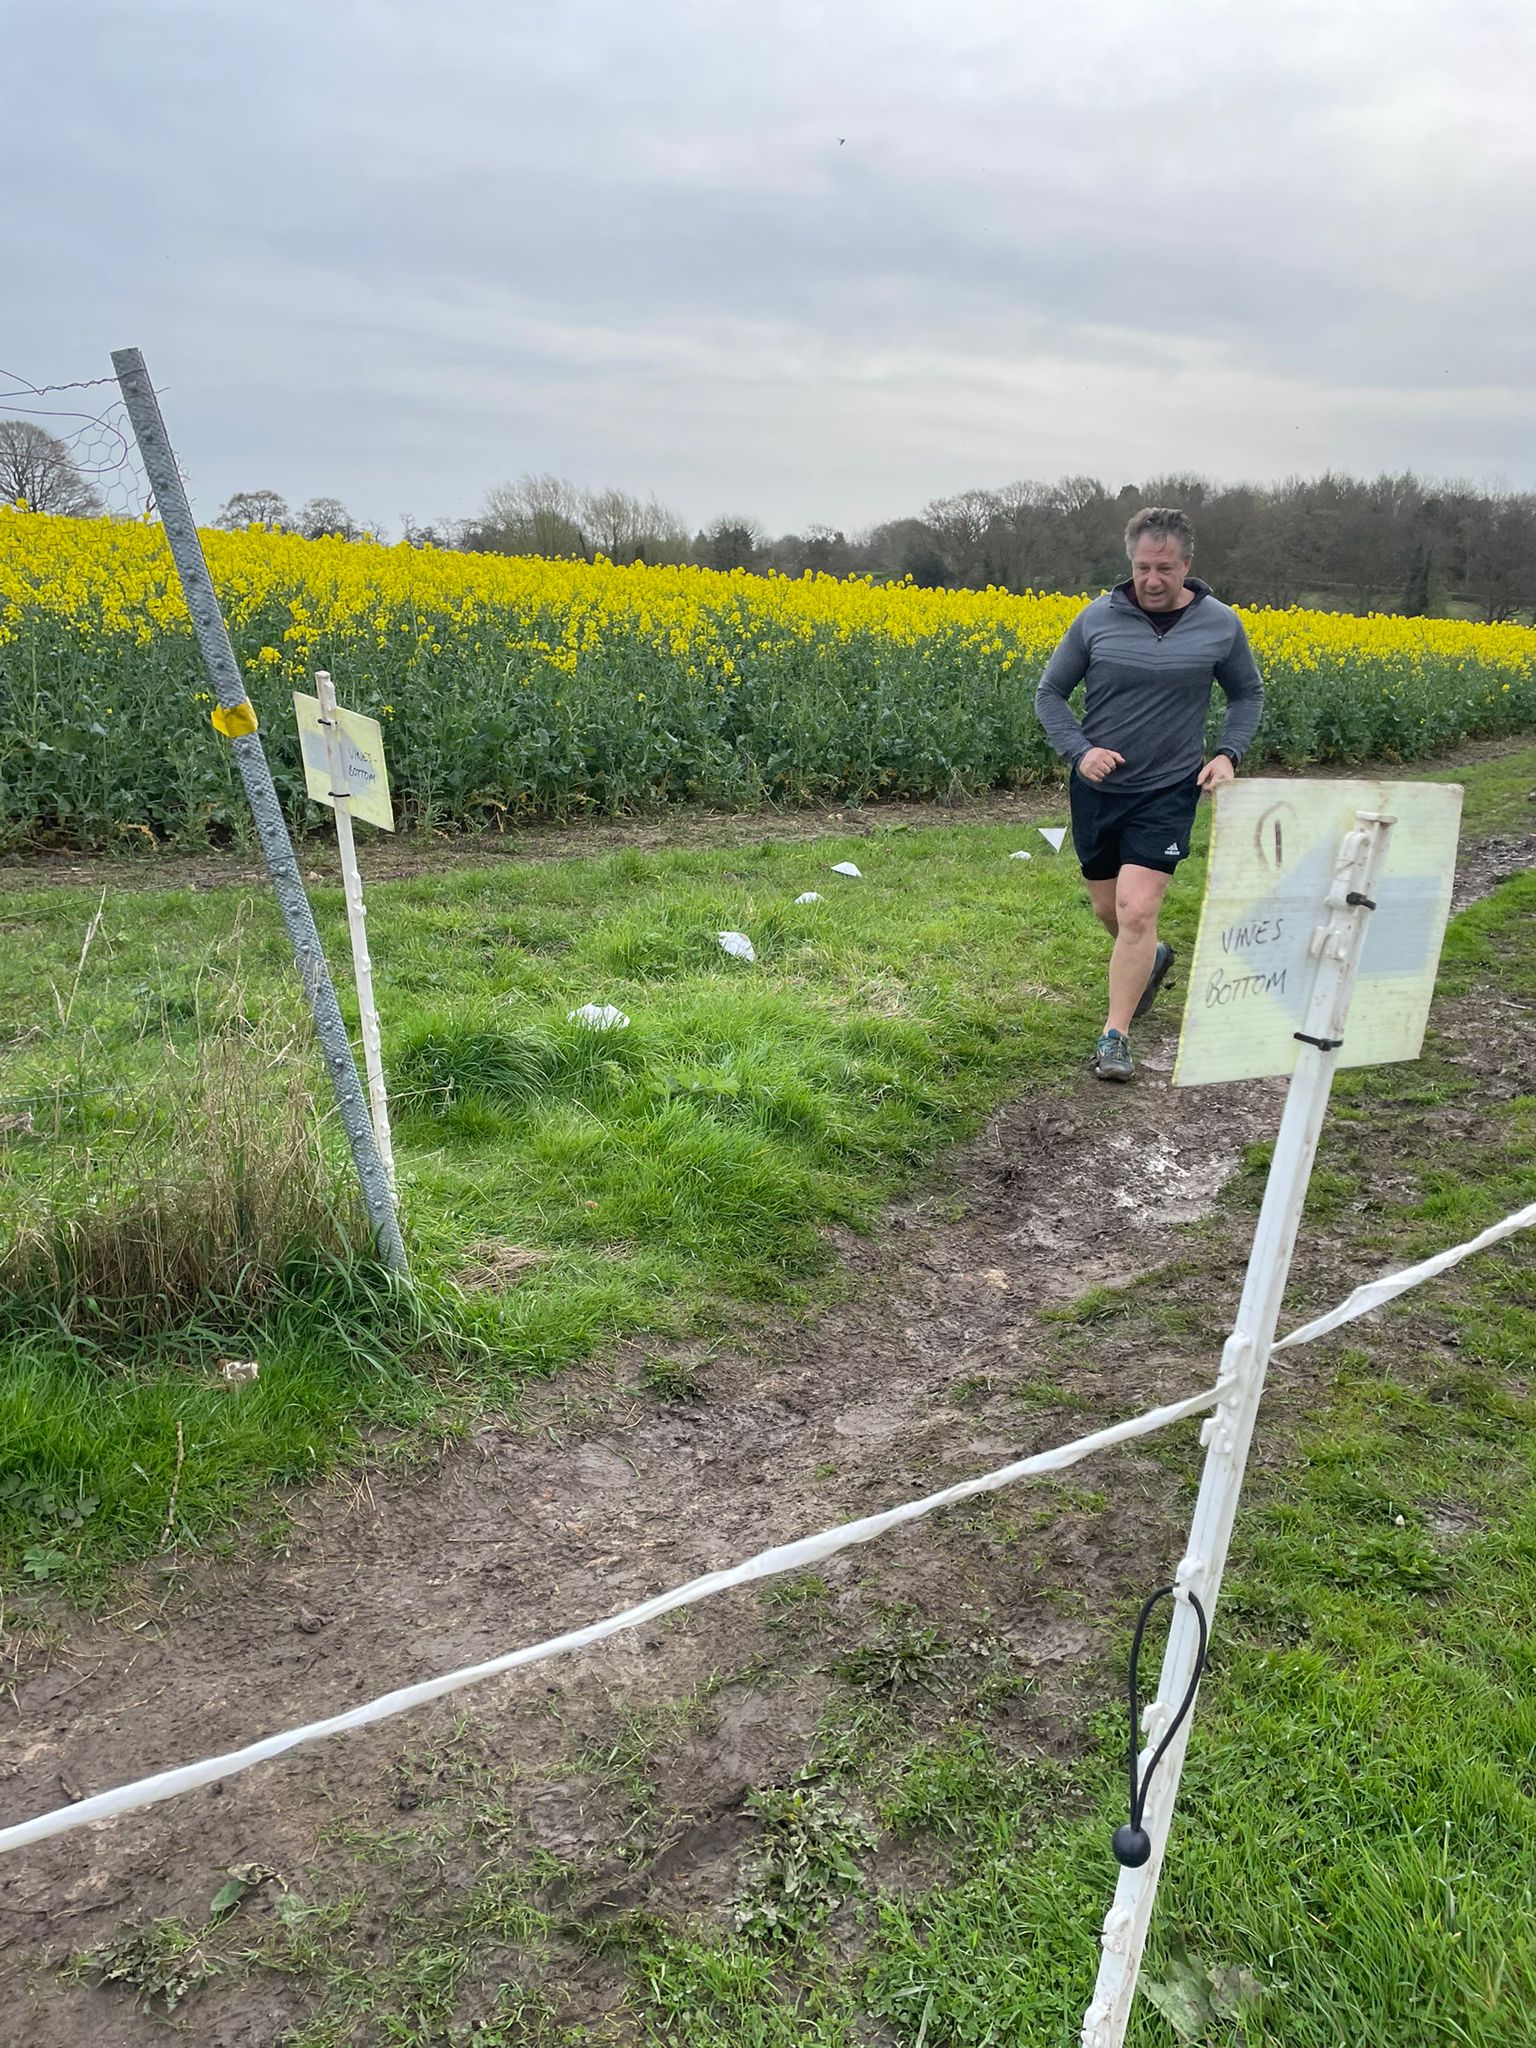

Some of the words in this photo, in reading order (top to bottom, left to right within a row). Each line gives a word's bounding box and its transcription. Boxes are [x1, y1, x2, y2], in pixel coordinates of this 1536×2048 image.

[349, 765, 375, 784] BOTTOM
[1222, 918, 1284, 954] VINES
[1206, 968, 1287, 1009] BOTTOM
